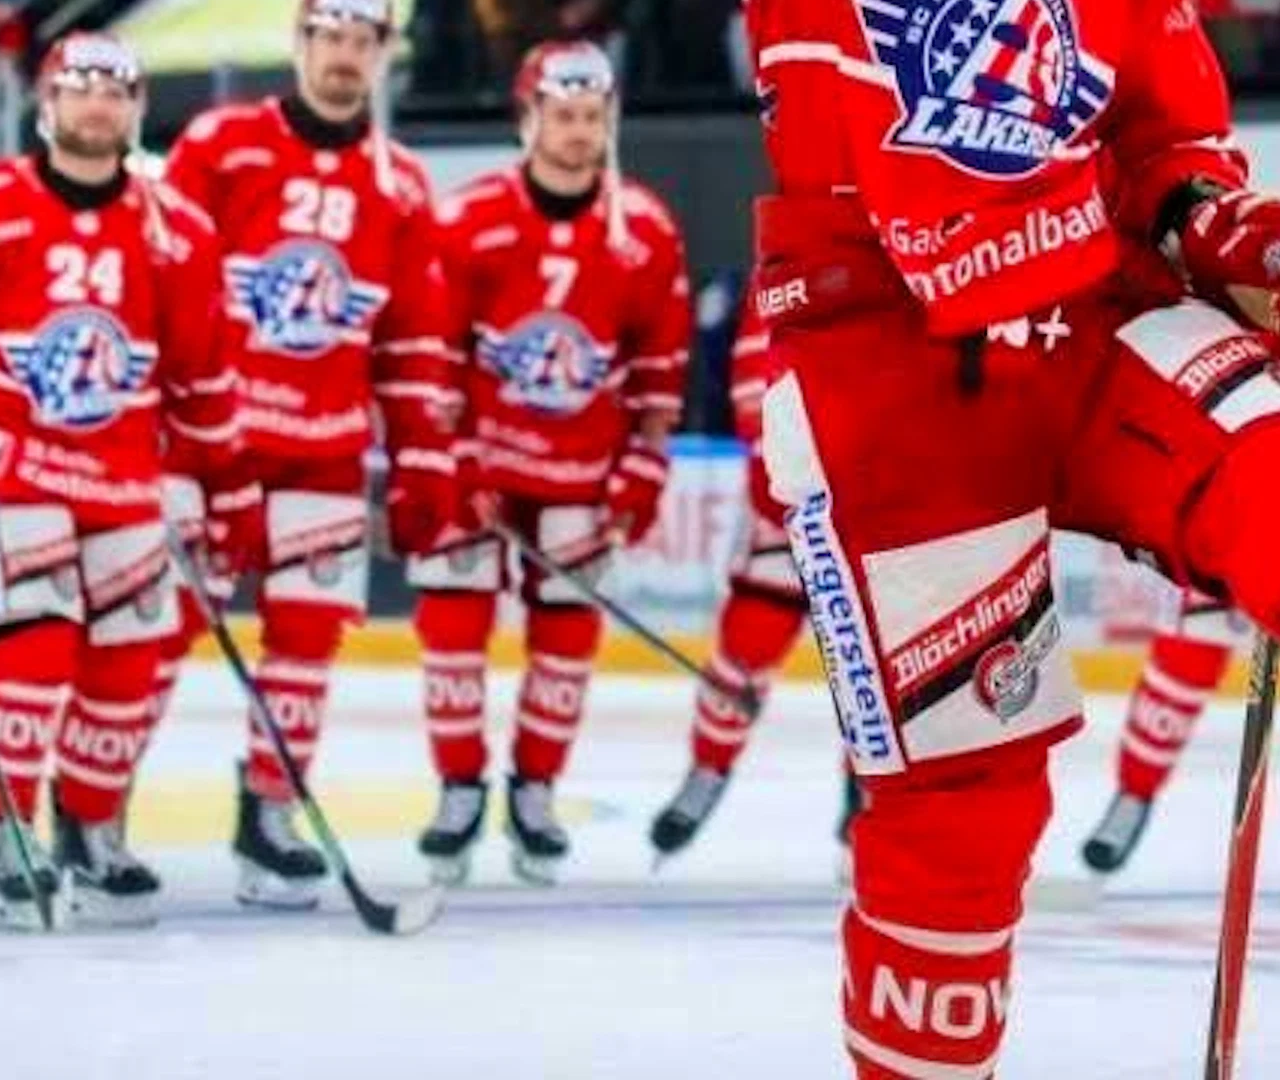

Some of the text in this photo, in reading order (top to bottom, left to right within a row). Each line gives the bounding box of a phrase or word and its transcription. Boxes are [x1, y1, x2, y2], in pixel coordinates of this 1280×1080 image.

[279, 177, 357, 242] 28
[45, 244, 124, 306] 24
[538, 255, 579, 309] 7
